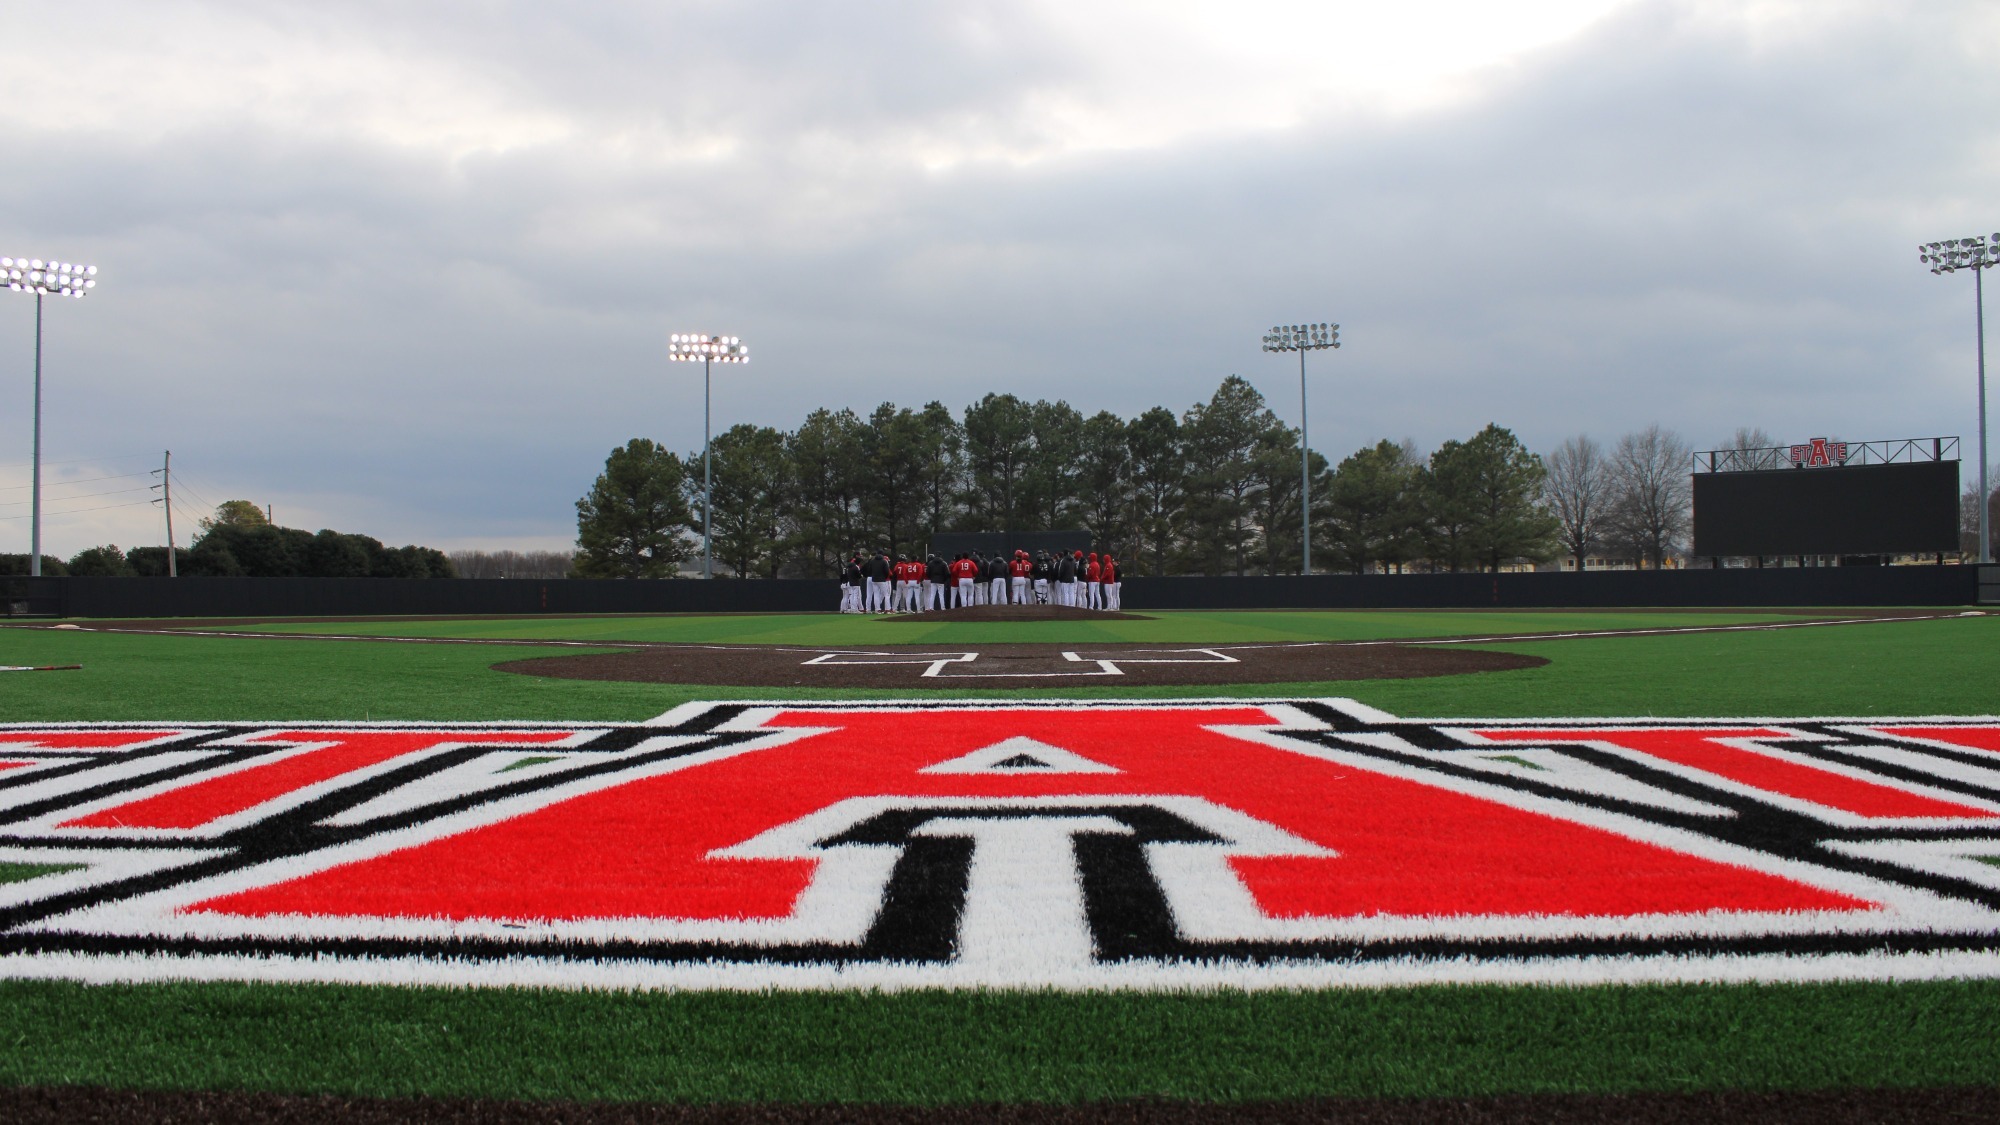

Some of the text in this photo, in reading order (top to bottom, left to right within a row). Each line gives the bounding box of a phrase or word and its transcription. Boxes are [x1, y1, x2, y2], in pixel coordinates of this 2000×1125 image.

[1791, 438, 1847, 467] STATE
[898, 566, 902, 574] 7
[907, 564, 917, 573] 24
[961, 562, 969, 571] 19
